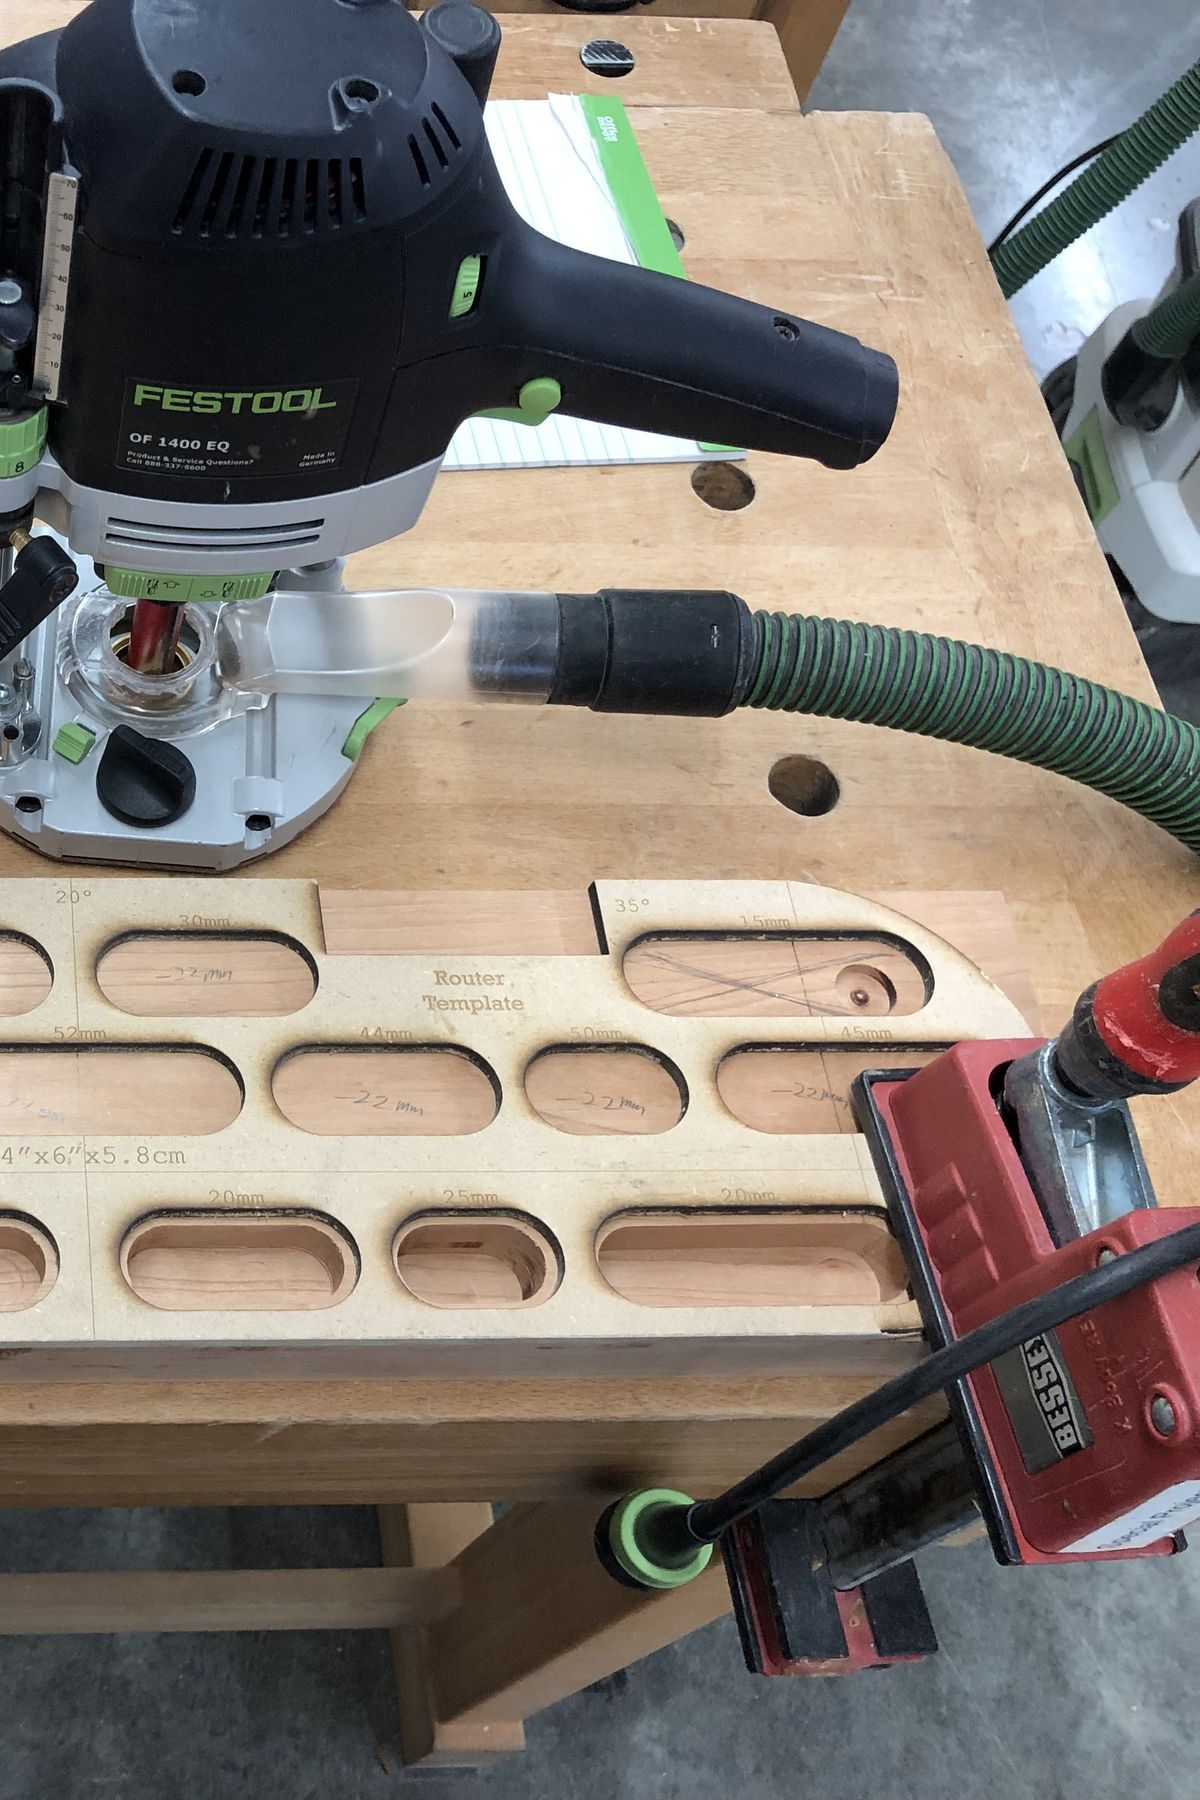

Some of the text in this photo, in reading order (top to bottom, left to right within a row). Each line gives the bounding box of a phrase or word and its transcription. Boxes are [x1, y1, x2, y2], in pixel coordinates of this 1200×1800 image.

[63, 212, 73, 221] 60
[61, 244, 70, 253] 50
[58, 275, 67, 283] 40
[55, 304, 65, 312] 30
[52, 333, 62, 341] 20
[134, 385, 337, 414] FESTOOL
[129, 433, 230, 453] OF 1400 EQ
[126, 457, 143, 465] Call
[127, 450, 161, 461] Product
[172, 457, 204, 465] Service
[299, 457, 336, 467] Germany
[15, 461, 24, 473] 8
[56, 890, 92, 904] 20°
[615, 899, 650, 912] 35°
[180, 915, 230, 928] 30mm
[740, 915, 791, 929] 15mm
[433, 970, 505, 986] Router
[422, 995, 525, 1015] Template
[54, 1026, 107, 1040] 52mm
[359, 1027, 413, 1041] 44mm
[570, 1027, 622, 1040] 50mm
[841, 1027, 892, 1040] 45mm
[209, 1189, 265, 1205] 20mm
[444, 1189, 499, 1203] 25mm
[721, 1187, 776, 1201] 20mm
